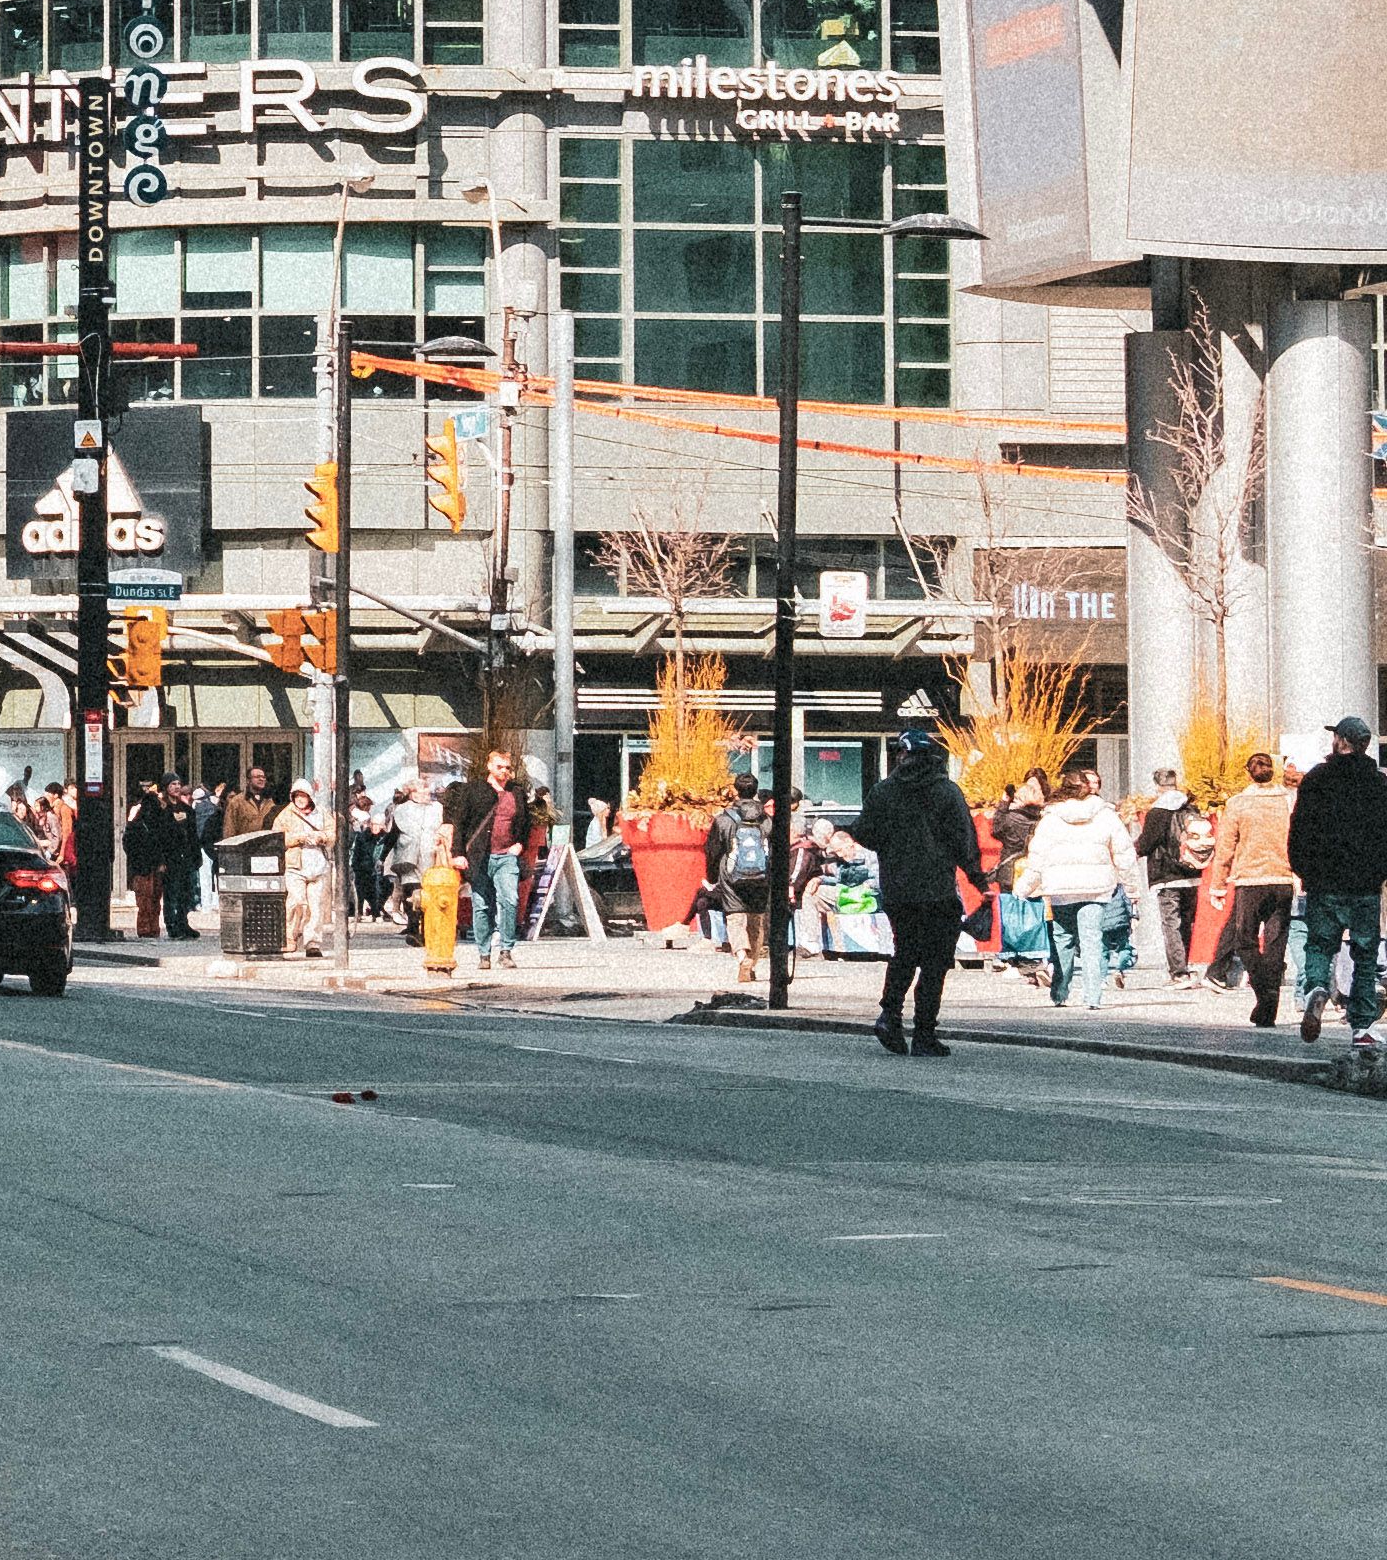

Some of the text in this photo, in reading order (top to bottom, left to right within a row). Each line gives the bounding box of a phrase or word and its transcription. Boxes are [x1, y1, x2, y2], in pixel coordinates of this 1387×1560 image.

[630, 54, 901, 104] milestones
[737, 109, 900, 132] GRILL BAR
[88, 94, 105, 262] DOWNTOWN
[115, 585, 175, 598] Dundas St E
[1065, 591, 1116, 619] THE
